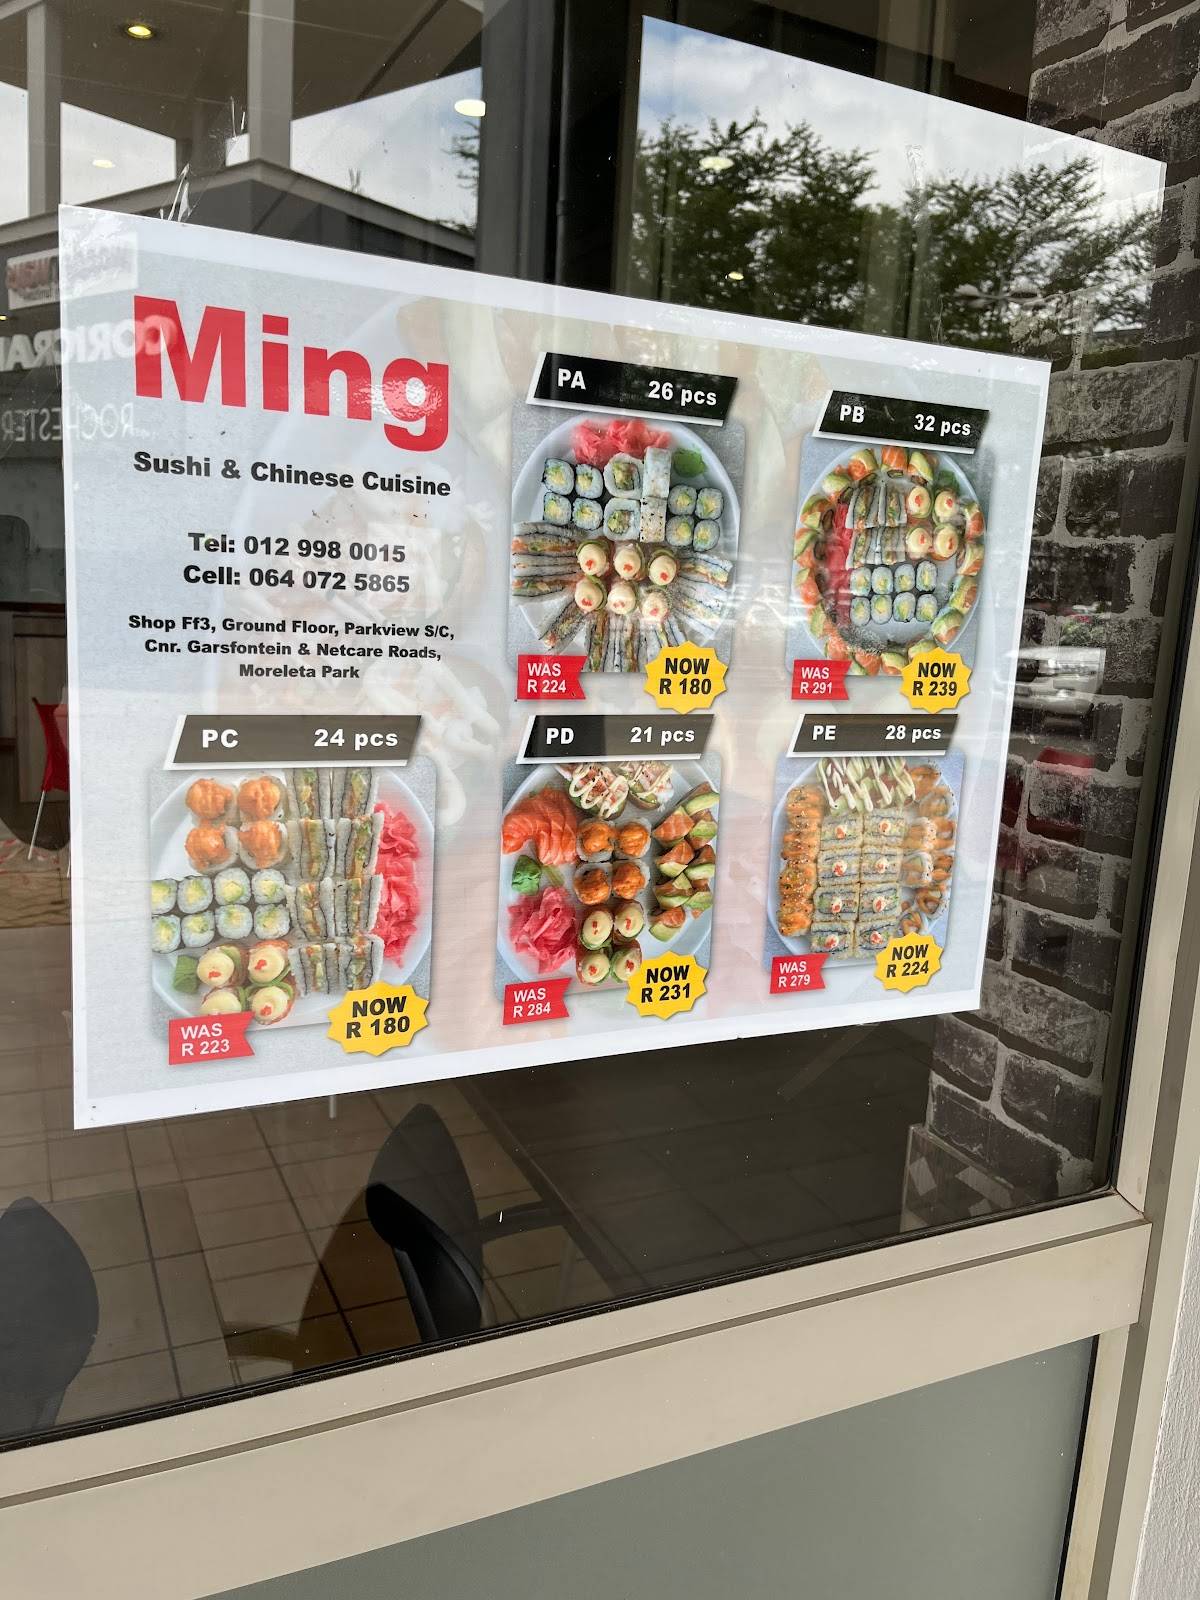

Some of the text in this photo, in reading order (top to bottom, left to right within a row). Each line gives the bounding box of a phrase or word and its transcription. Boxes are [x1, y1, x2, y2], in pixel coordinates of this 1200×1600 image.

[134, 295, 449, 452] Ming
[557, 368, 717, 406] PA 26 pcs
[840, 405, 971, 437] PB 32 pcs
[133, 451, 451, 496] Sushi & Chinese Cuisine
[188, 533, 406, 563] Tel: 012 998 0015
[183, 565, 410, 594] Cell: 064 072 5865
[128, 614, 455, 641] Shop Ff3, Ground Floor, Parkview S/C,
[144, 639, 441, 662] Cnr. Garsfontein & Netcare Roads,
[239, 664, 360, 679] Moreleta Park
[527, 662, 561, 677] WAS
[664, 657, 710, 676] NOW
[801, 666, 830, 680] WAS
[917, 662, 956, 678] NOW
[527, 678, 567, 693] R 224
[659, 678, 712, 695] R 180
[800, 681, 832, 694] R 291
[912, 680, 958, 697] R 239
[202, 729, 398, 750] PC 24 pcs
[546, 727, 695, 745] PD 21 pcs
[812, 725, 942, 743] PE 28 pcs
[891, 944, 929, 961] NOW
[646, 965, 690, 984] NOW
[779, 960, 807, 974] WAS
[886, 960, 929, 978] R 224
[778, 972, 811, 987] R 279
[514, 987, 547, 1002] WAS
[641, 983, 691, 1004] R 231
[352, 996, 407, 1017] NOW
[513, 1002, 551, 1018] R 284
[181, 1023, 223, 1039] WAS
[346, 1015, 410, 1038] R 180
[181, 1040, 230, 1056] R 223
